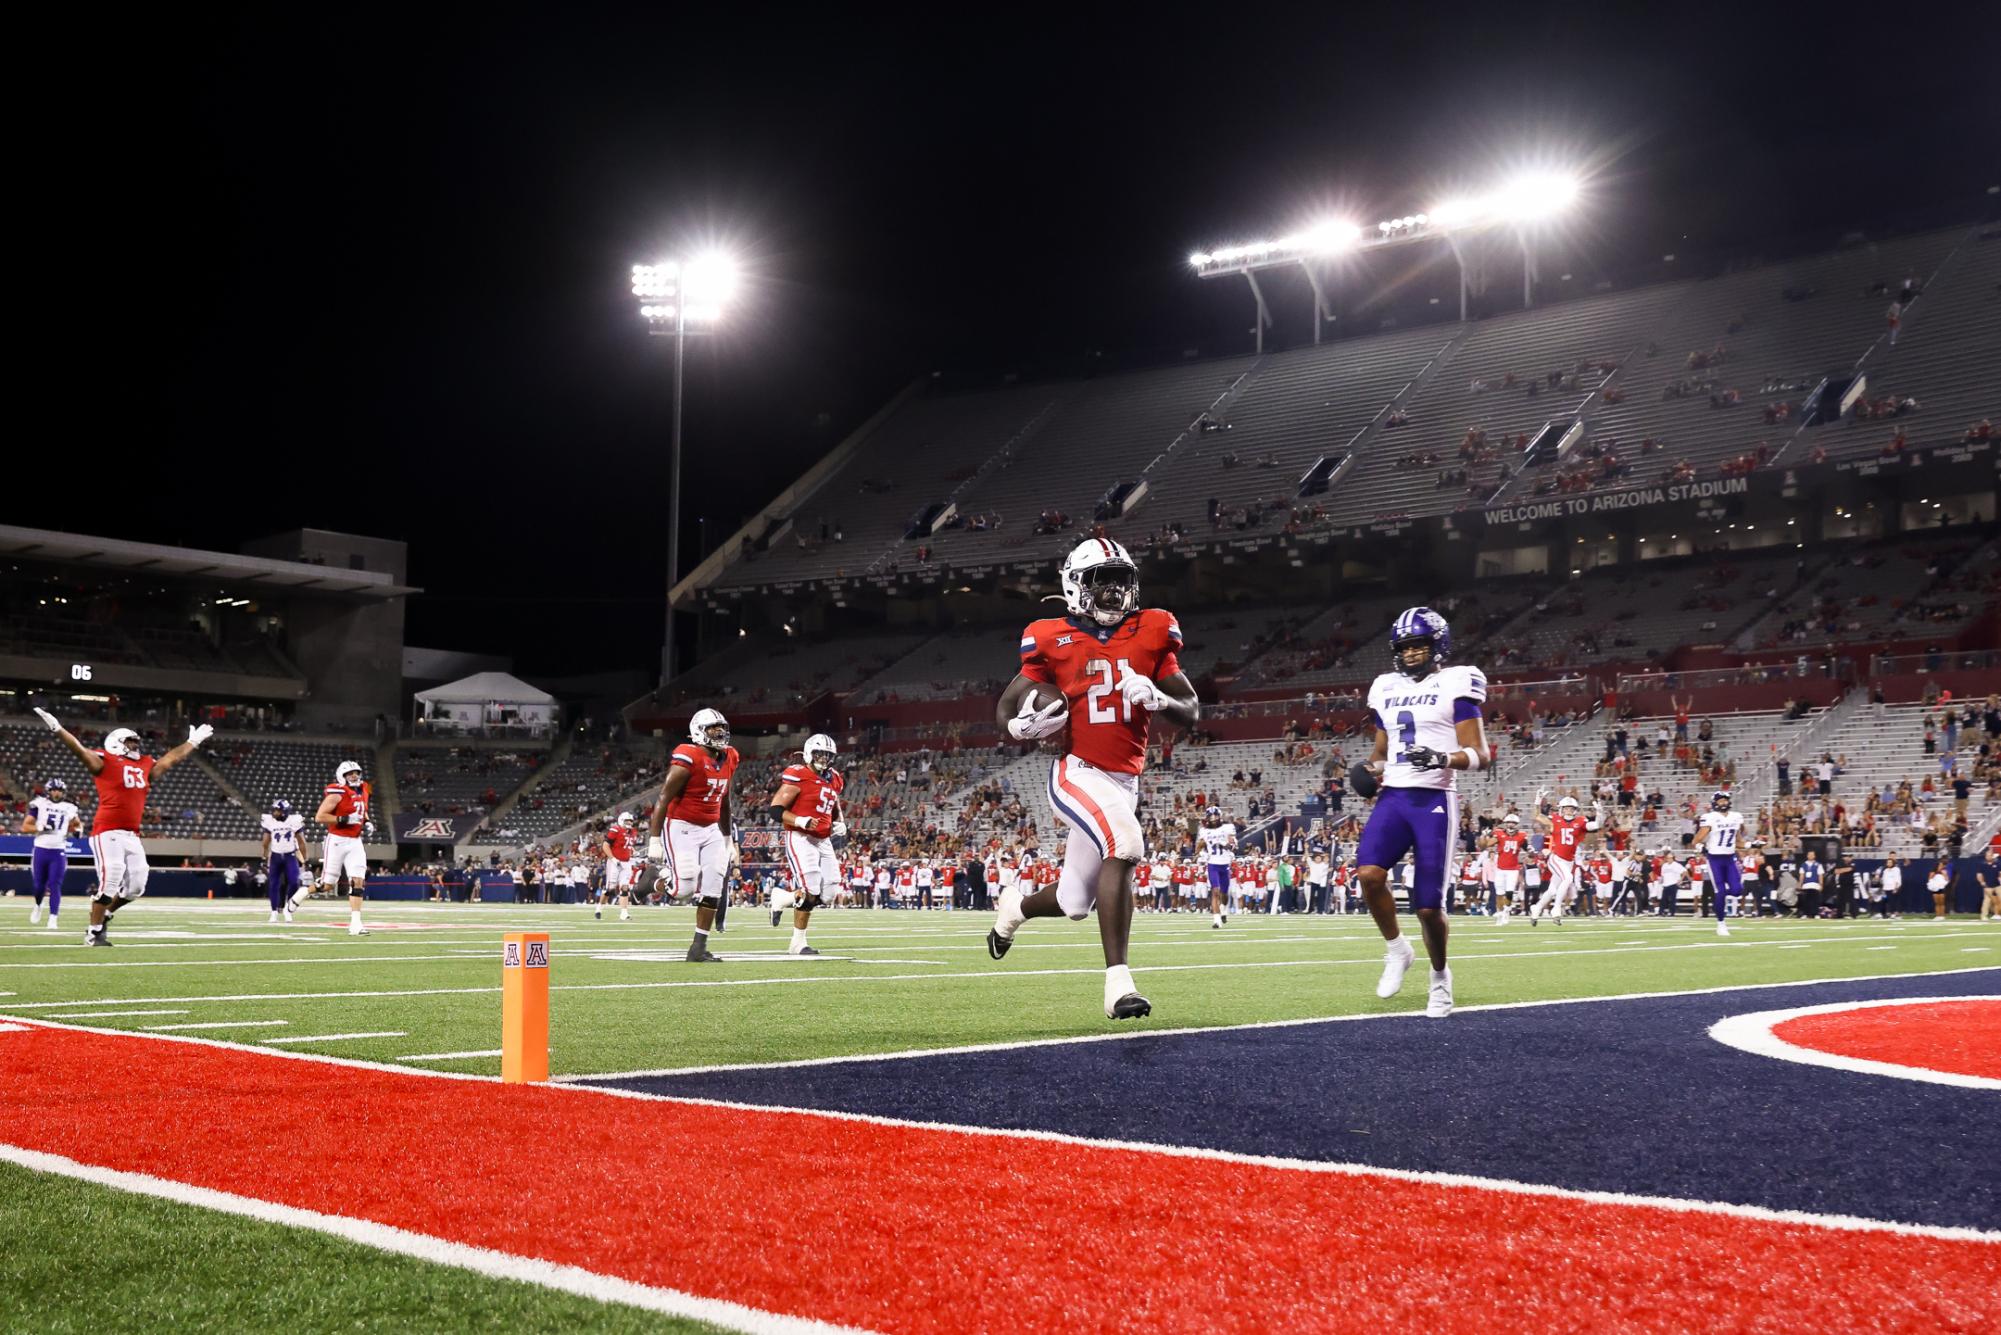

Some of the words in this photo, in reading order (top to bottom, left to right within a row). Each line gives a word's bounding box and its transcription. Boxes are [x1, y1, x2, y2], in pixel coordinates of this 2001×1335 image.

[1486, 502, 1562, 524] WELCOME
[1567, 498, 1588, 514] TO
[1592, 489, 1663, 511] ARIZONA
[1668, 478, 1748, 501] STADIUM
[71, 664, 92, 681] 06
[1086, 658, 1131, 724] 21
[1385, 694, 1439, 709] WILDCATS
[123, 765, 146, 789] 63
[704, 778, 728, 802] 77
[46, 814, 65, 831] 51
[274, 831, 292, 843] 44
[1560, 828, 1575, 845] 15
[1718, 829, 1735, 847] 12
[1503, 840, 1518, 855] 84
[526, 943, 547, 966] A
